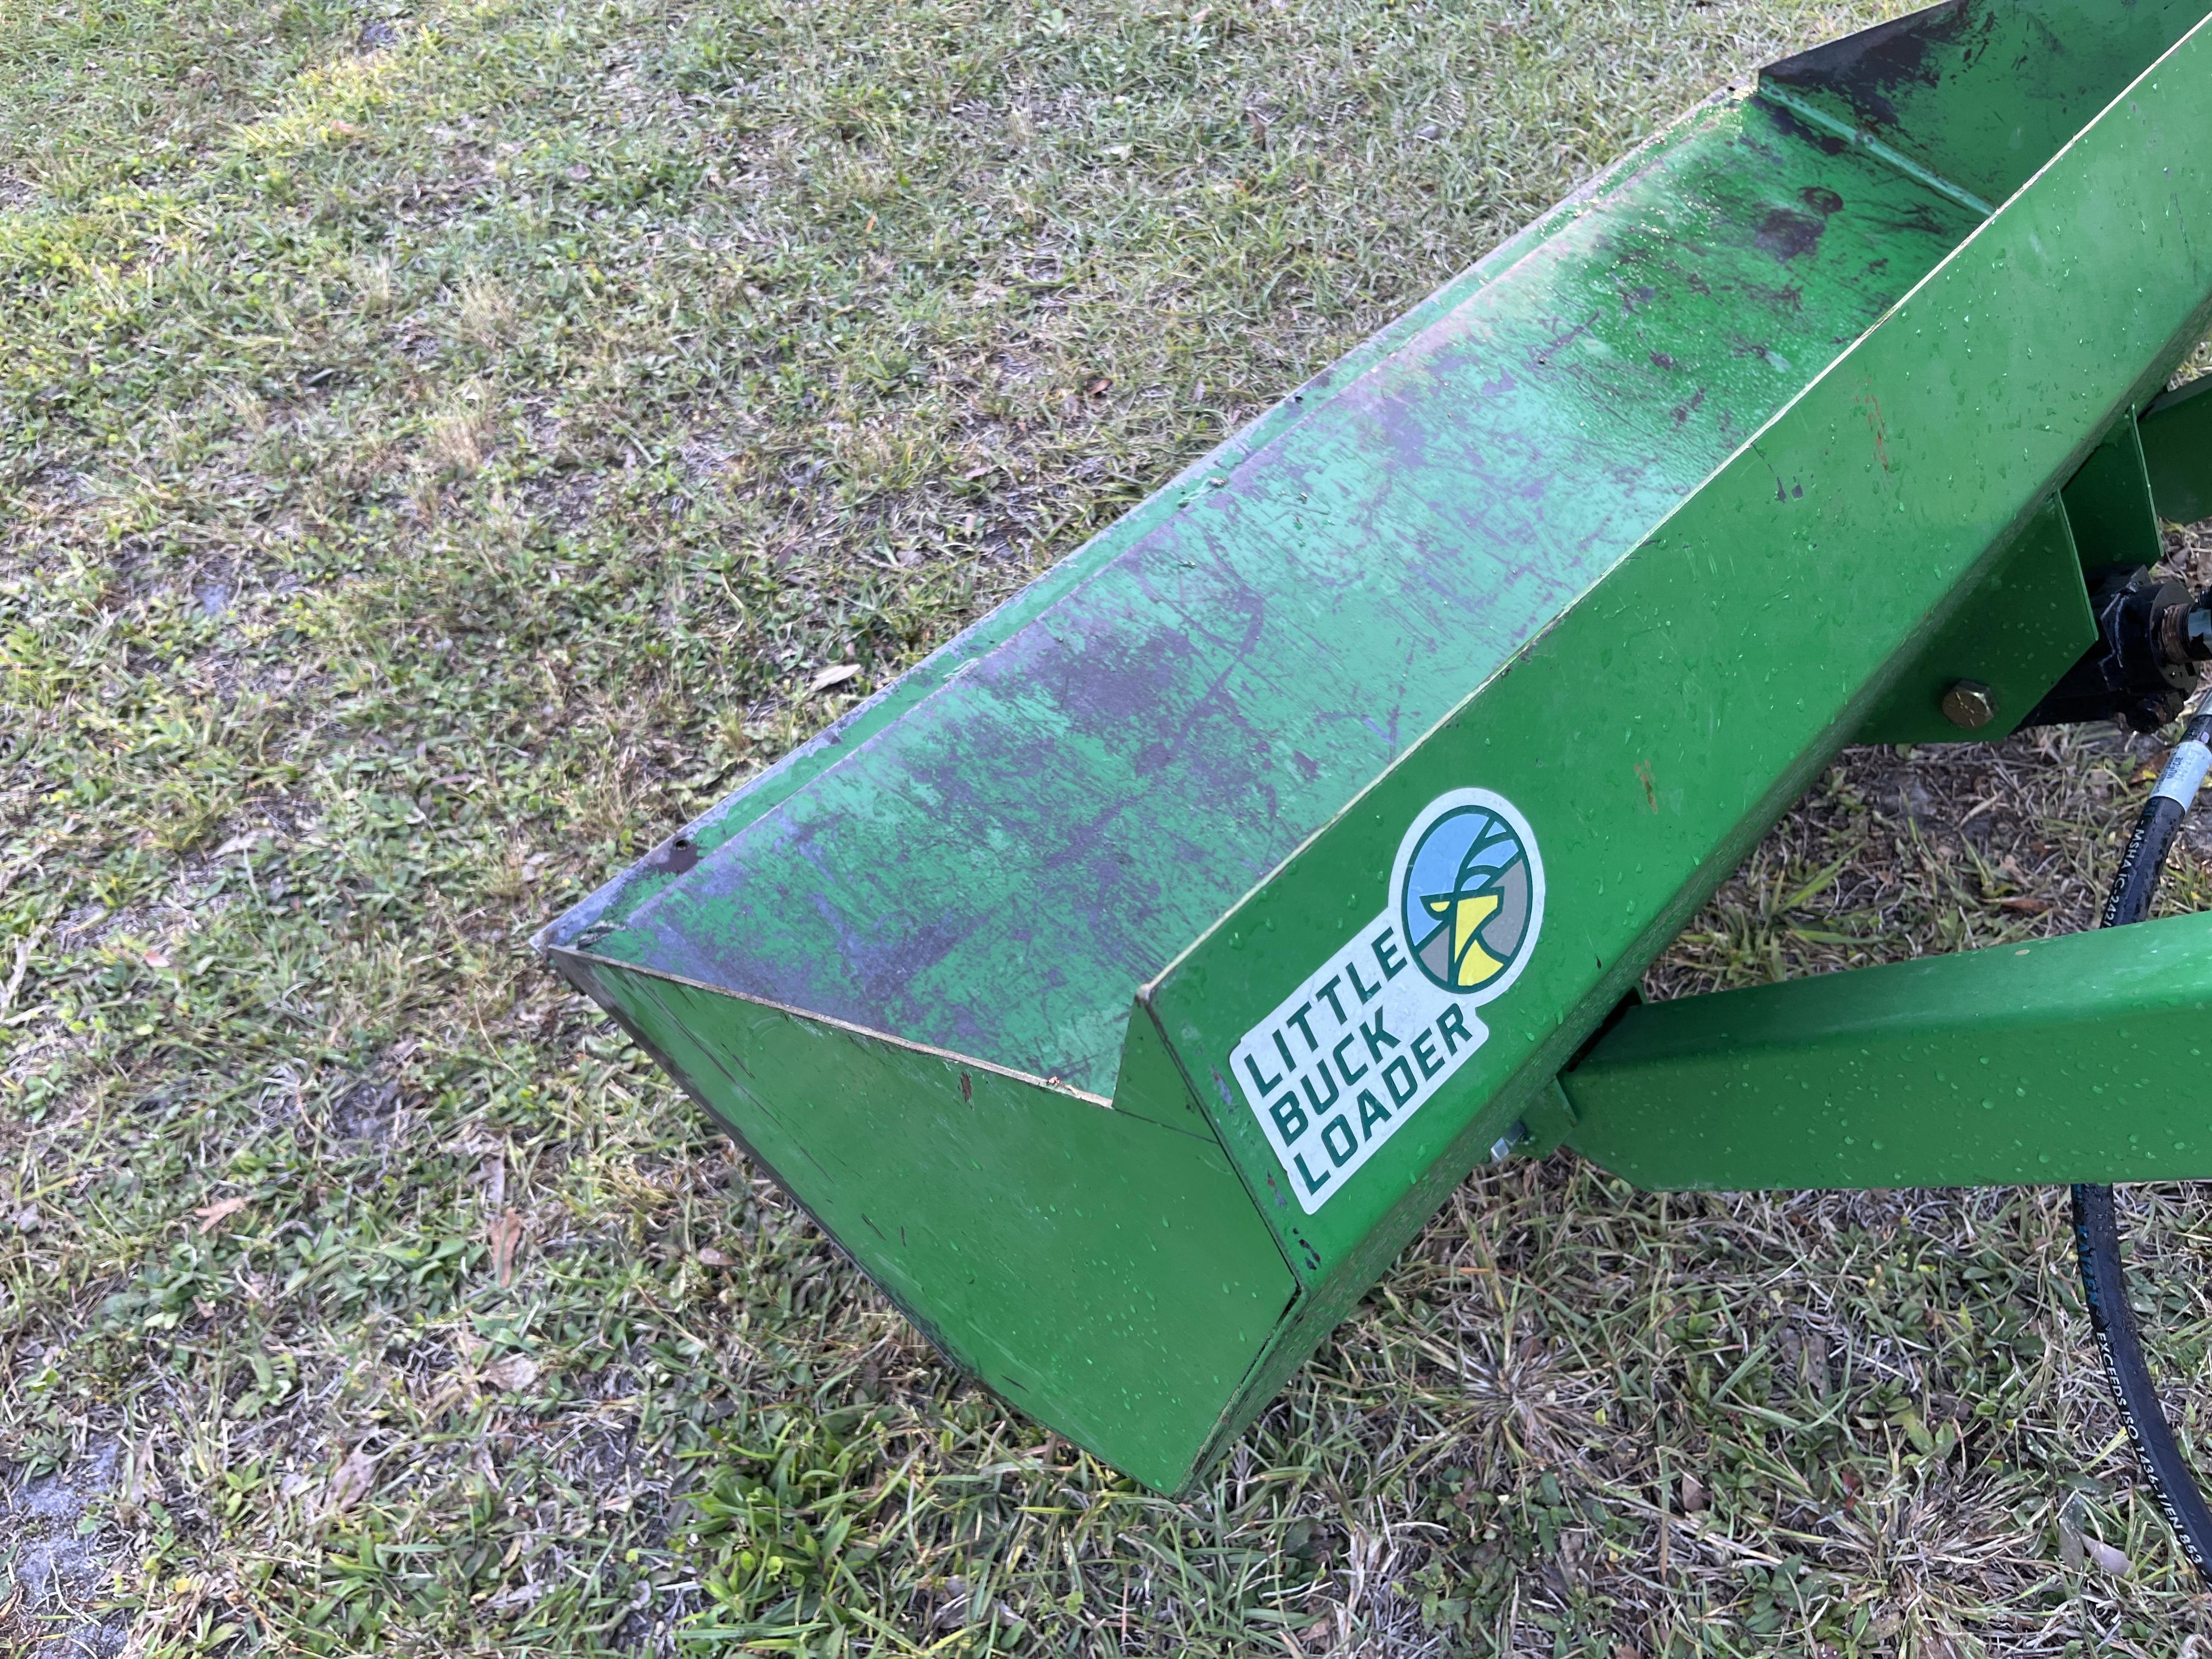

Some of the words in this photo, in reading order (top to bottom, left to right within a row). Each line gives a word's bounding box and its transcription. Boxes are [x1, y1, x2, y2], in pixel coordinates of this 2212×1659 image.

[2121, 829, 2145, 870] MSHA
[1244, 927, 1408, 1097] LITTLE
[1269, 1006, 1401, 1147] BUCK
[1293, 1002, 1474, 1196] LOADER
[2096, 1331, 2127, 1406] EXCEEDS
[2121, 1410, 2139, 1440] ISO
[2136, 1446, 2185, 1530] 1436-1/EN
[2179, 1534, 2203, 1564] 853
